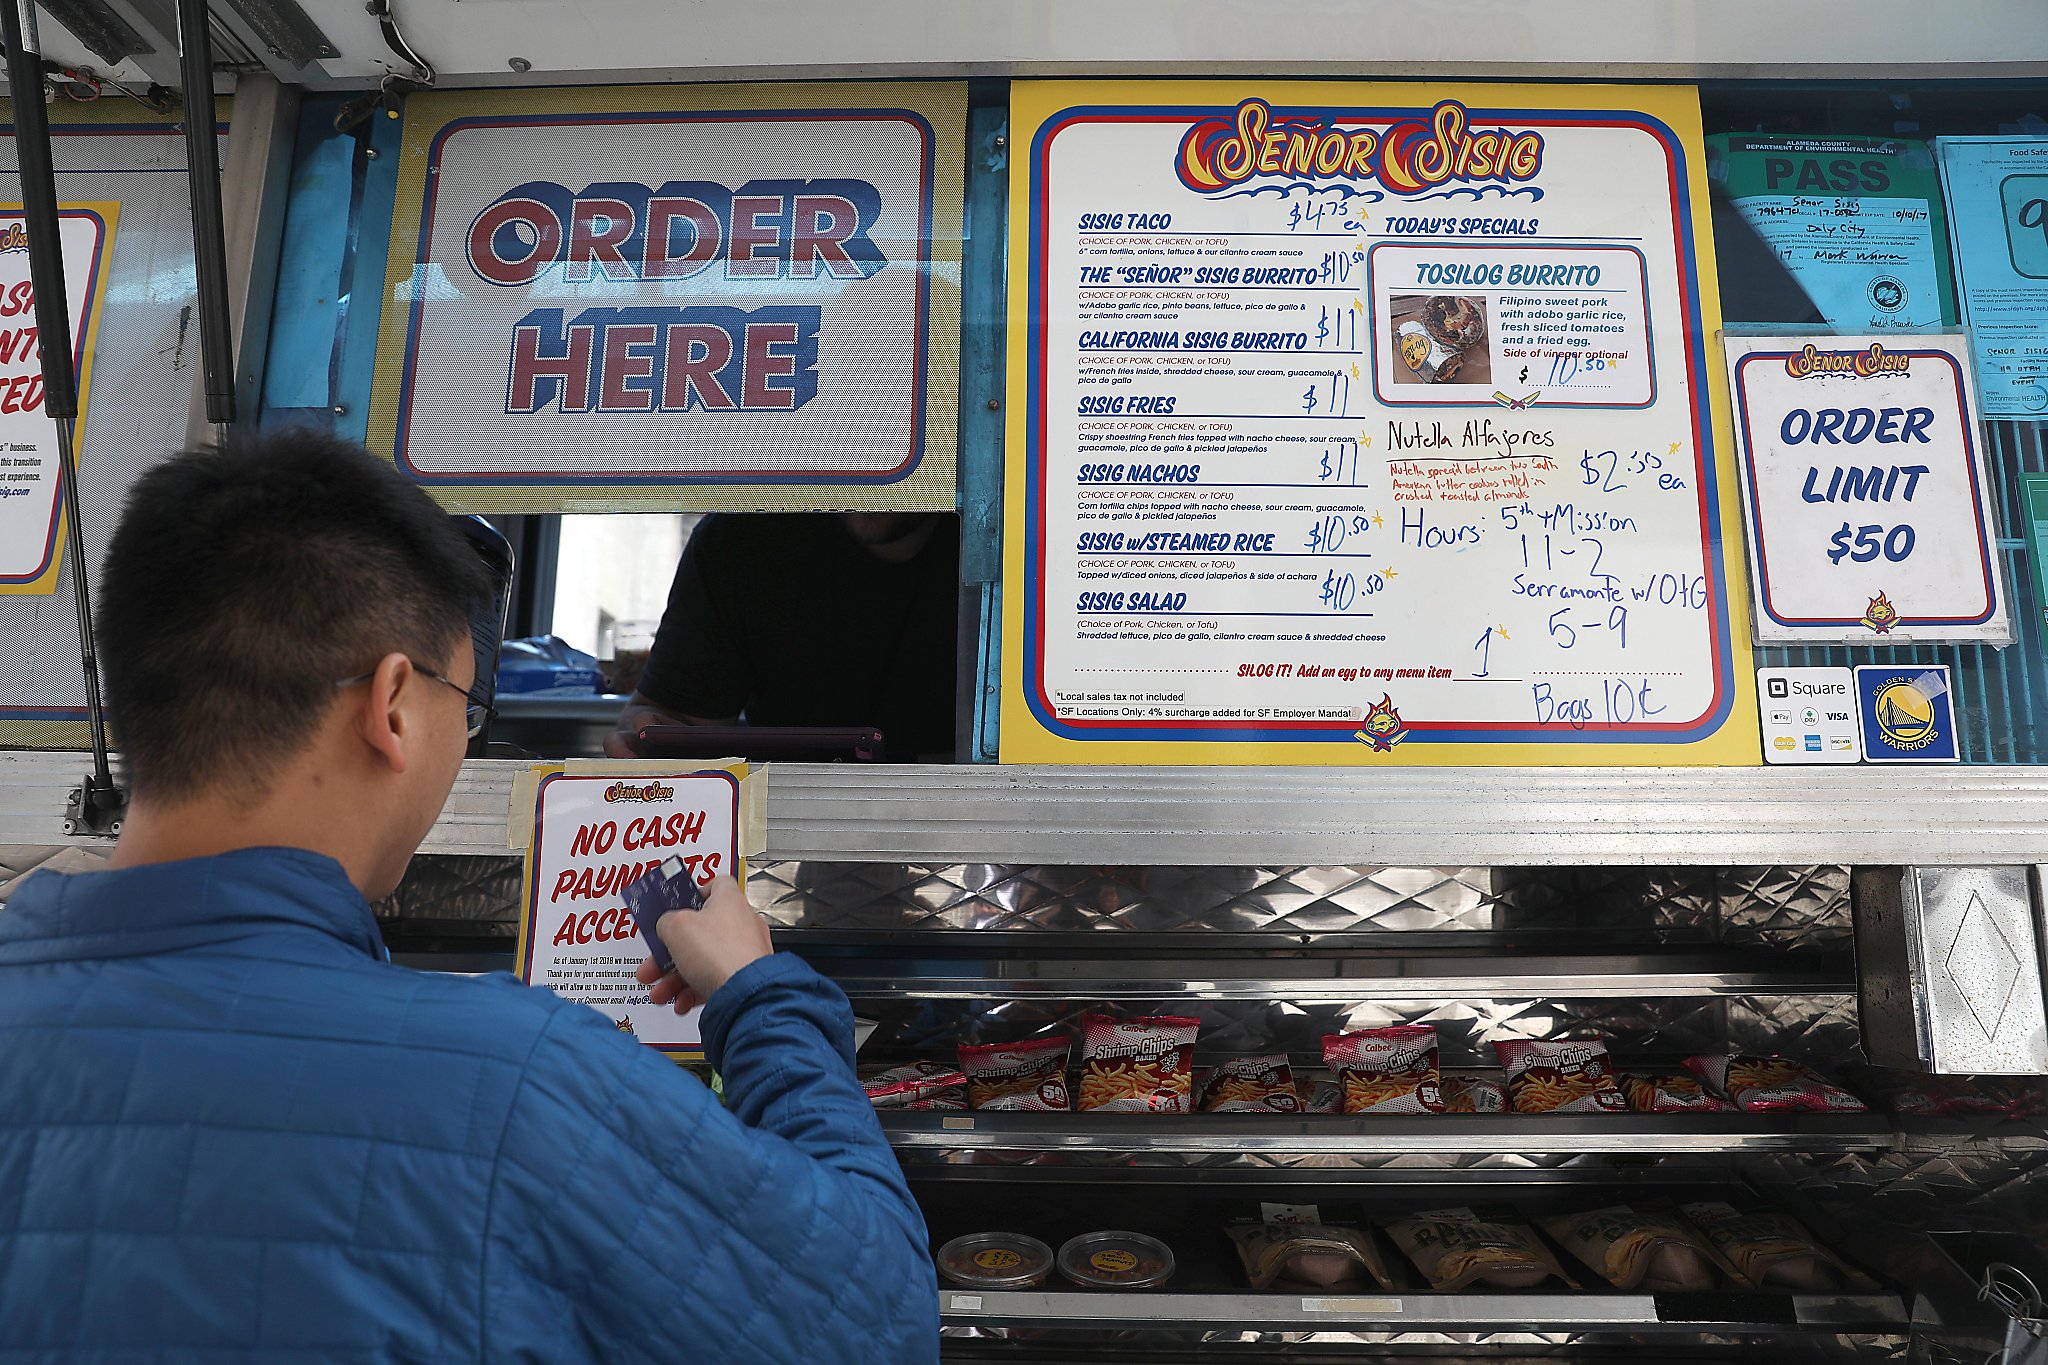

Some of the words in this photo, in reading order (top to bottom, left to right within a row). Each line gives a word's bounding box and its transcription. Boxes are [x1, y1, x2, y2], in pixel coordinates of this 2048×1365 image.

[1411, 101, 1543, 184] SISIG
[1745, 143, 1793, 151] DEPARTMENT
[1866, 147, 1894, 155] HEALTH
[1765, 158, 1891, 193] PASS
[1078, 213, 1124, 230] SISIG
[1127, 213, 1171, 230] TACO
[1384, 217, 1457, 235] TODAY'S
[1459, 218, 1539, 235] SPECIALS
[1840, 220, 1866, 239] City
[466, 179, 888, 287] ORDER
[1079, 238, 1114, 246] (CHOICE
[1109, 248, 1135, 256] tortilla,
[1137, 248, 1165, 256] onions,
[1080, 266, 1113, 283] THE
[1194, 267, 1240, 284] SISIG
[1242, 267, 1318, 285] BURRITO
[1416, 263, 1503, 285] TOSILOG
[1507, 264, 1600, 286] BURRITO
[1499, 296, 1542, 307] Filipino
[1545, 298, 1579, 306] sweet
[1581, 298, 1608, 308] pork
[1500, 309, 1524, 318] with
[1527, 310, 1563, 319] adobo
[1566, 310, 1599, 321] garlic
[1602, 310, 1626, 321] rice,
[1315, 305, 1356, 350] $11
[1501, 322, 1530, 331] fresh
[1533, 323, 1568, 332] sliced
[1571, 324, 1624, 333] tomatoes
[1079, 331, 1179, 348] CALIFORNIA
[1182, 331, 1229, 349] SISIG
[1231, 332, 1307, 350] BURRITO
[1502, 336, 1524, 344] and
[1537, 336, 1564, 345] fried
[1567, 338, 1591, 347] egg.
[505, 305, 822, 414] HERE
[1503, 348, 1527, 358] Side
[1530, 349, 1541, 358] of
[1543, 349, 1583, 359] vinegar
[1585, 350, 1628, 360] optional
[1865, 342, 1910, 373] SISIG
[1518, 365, 1529, 384] $
[1077, 396, 1124, 413] SISIG
[1126, 396, 1176, 414] FRIES
[2021, 394, 2046, 402] HEALTH
[1780, 407, 1935, 446] ORDER
[9, 442, 37, 452] business.
[1387, 419, 1453, 451] Nutella
[1462, 419, 1556, 457] Alfajores
[0, 457, 12, 467] this
[13, 457, 42, 467] transition
[7, 472, 41, 483] experience.
[1077, 464, 1125, 482] SISIG
[1126, 464, 1201, 482] NACHOS
[1658, 472, 1687, 491] ea
[1801, 464, 1931, 504] LIMIT
[1304, 515, 1370, 553] $10.50
[1400, 506, 1487, 548] Hours:
[1077, 532, 1125, 551] SISIG
[1126, 532, 1231, 552] w/STEAMED
[1233, 533, 1275, 552] RICE
[1826, 521, 1917, 566] $50
[1318, 569, 1384, 611] $10.50
[1511, 573, 1624, 602] Serramonte
[1076, 592, 1125, 611] SISIG
[1126, 592, 1187, 611] SALAD
[1237, 663, 1274, 677] SILOG
[1276, 664, 1293, 677] IT!
[1296, 664, 1321, 678] Add
[1321, 668, 1336, 677] an
[1338, 668, 1357, 680] egg
[1360, 666, 1371, 678] to
[1373, 668, 1394, 680] any
[1396, 668, 1425, 678] menu
[1427, 665, 1452, 678] item
[1792, 680, 1847, 698] Square
[1872, 676, 1905, 697] GOLDEN
[1087, 692, 1111, 701] sales
[1113, 693, 1127, 701] tax
[1129, 693, 1143, 701] not
[1146, 693, 1183, 702] included
[1532, 682, 1594, 731] Bags
[1076, 707, 1119, 716] Locations
[1121, 707, 1145, 718] Only:
[1148, 708, 1163, 716] 4%
[1165, 708, 1210, 718] surcharge
[1212, 709, 1241, 717] added
[1243, 709, 1255, 717] for
[1257, 708, 1270, 718] SF
[1273, 709, 1315, 719] Employer
[1825, 712, 1850, 721] VISA
[1878, 729, 1940, 752] WARRIORS
[570, 820, 618, 858] NO
[622, 810, 707, 853] CASH
[551, 852, 722, 904] PAYMTS
[568, 956, 588, 967] January
[590, 956, 599, 965] 1st
[599, 956, 614, 965] 2018
[1095, 1042, 1140, 1060] Shrimp
[1141, 1035, 1176, 1055] Chips
[1365, 1043, 1393, 1052] Calbee
[977, 1064, 1018, 1079] Shrimp
[1020, 1055, 1051, 1072] Chips
[1134, 1053, 1158, 1062] BAKED
[1388, 1048, 1420, 1069] Chips
